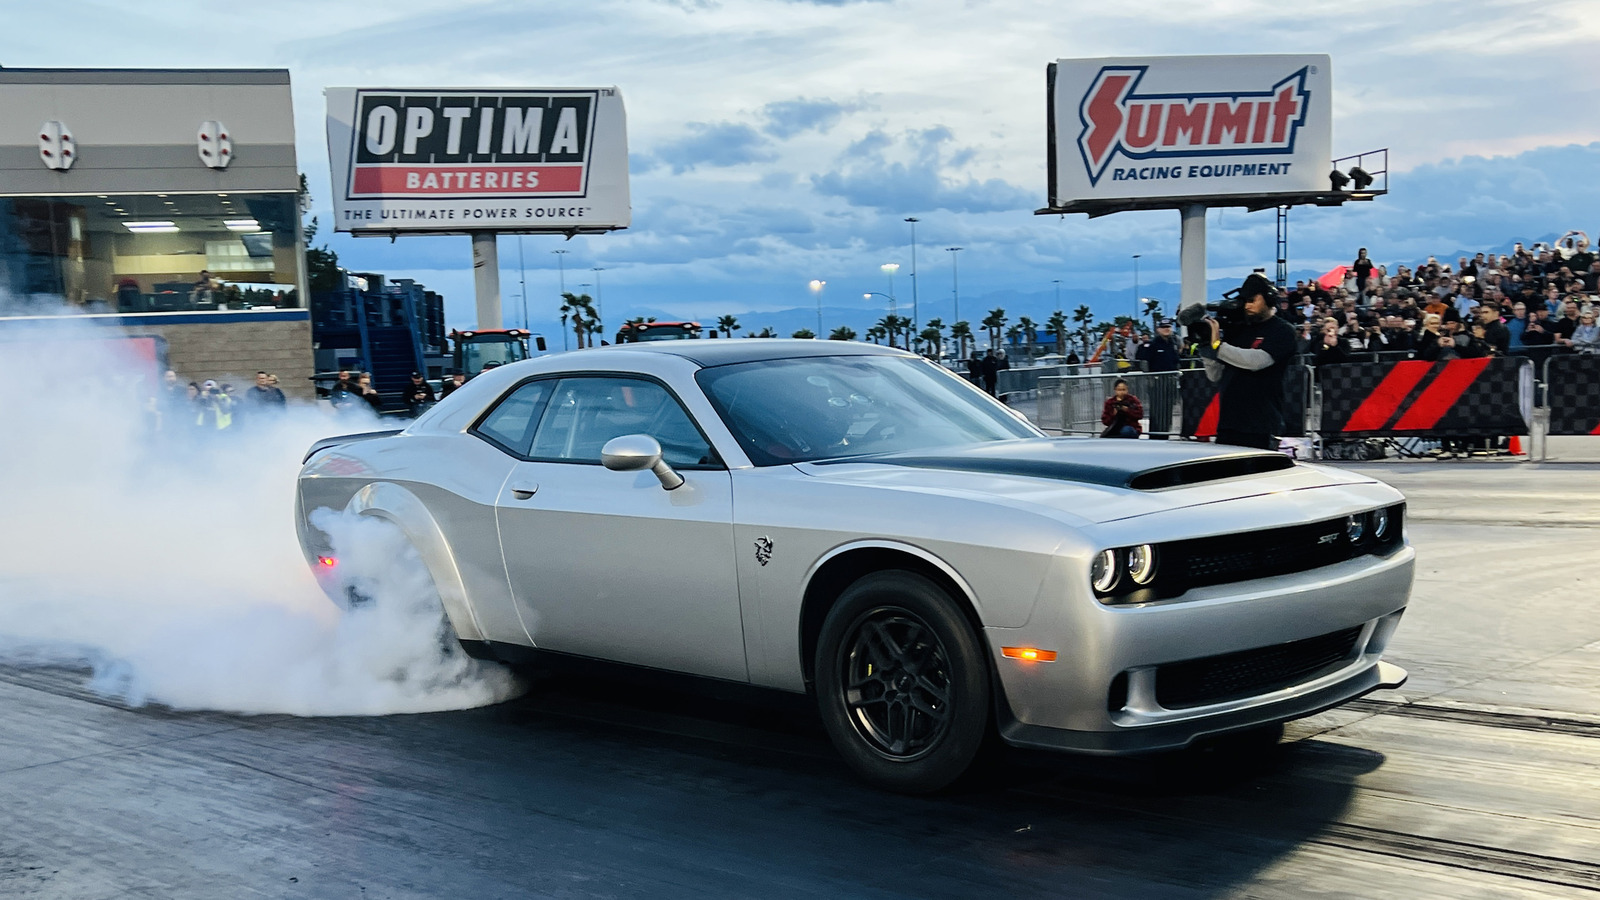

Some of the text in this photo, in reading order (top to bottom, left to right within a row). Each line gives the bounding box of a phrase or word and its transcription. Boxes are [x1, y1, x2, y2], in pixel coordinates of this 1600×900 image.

[365, 105, 579, 155] OPTIMA
[406, 171, 540, 189] BATTERIES
[1112, 162, 1292, 181] RACING EQUIPMENT
[344, 209, 372, 221] THE
[380, 208, 455, 220] ULTIMATE
[463, 208, 518, 219] POWER
